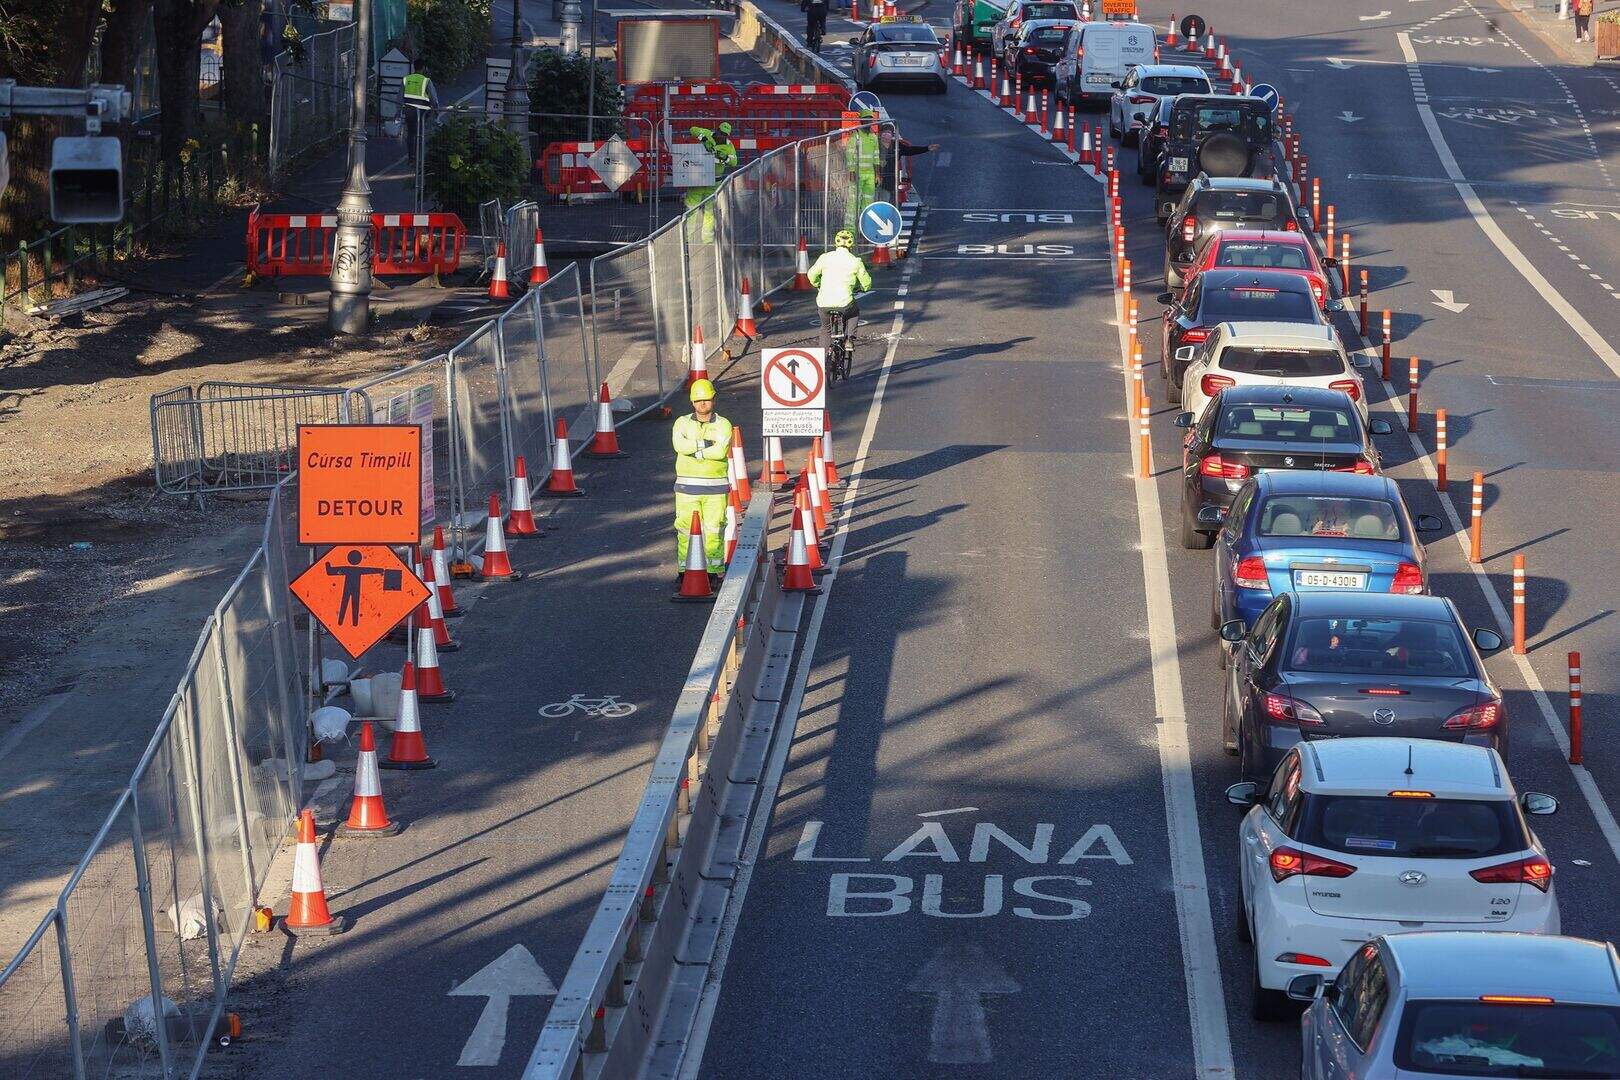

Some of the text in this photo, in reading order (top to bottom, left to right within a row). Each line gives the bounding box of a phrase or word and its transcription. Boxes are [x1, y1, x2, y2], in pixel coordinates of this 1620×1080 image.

[962, 213, 1074, 224] BUS
[957, 244, 1074, 255] BUS
[307, 451, 412, 471] Cúrsa Timpill
[317, 500, 404, 516] DETOUR
[1307, 574, 1358, 587] 05-D-43019
[792, 806, 1134, 865] LÁNA
[825, 872, 1093, 921] BUS
